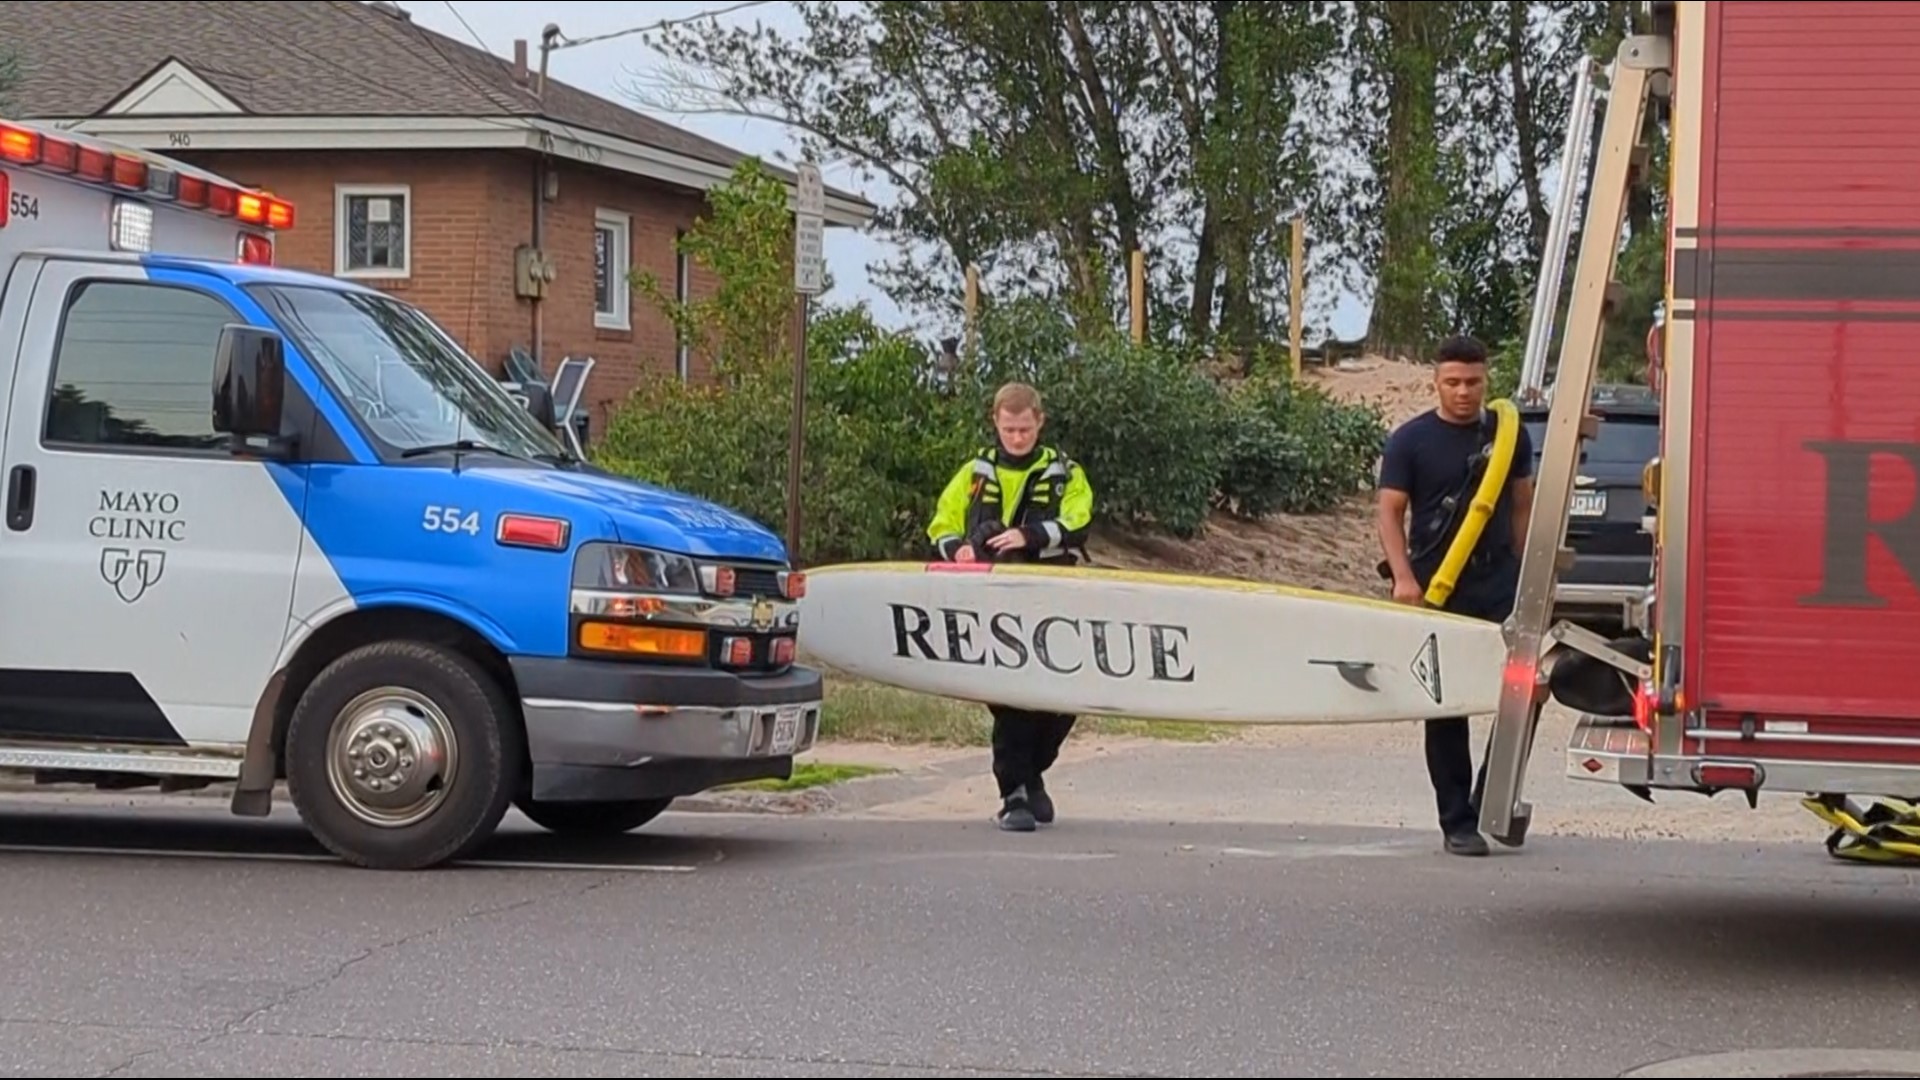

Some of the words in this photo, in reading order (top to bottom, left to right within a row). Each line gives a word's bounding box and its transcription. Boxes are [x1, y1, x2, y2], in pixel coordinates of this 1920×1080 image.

[169, 132, 191, 146] 940
[10, 192, 39, 220] 554
[99, 490, 179, 514] MAYO
[89, 516, 186, 541] CLINIC
[422, 505, 480, 536] 554
[1797, 441, 1920, 608] R
[887, 603, 1195, 683] RESCUE
